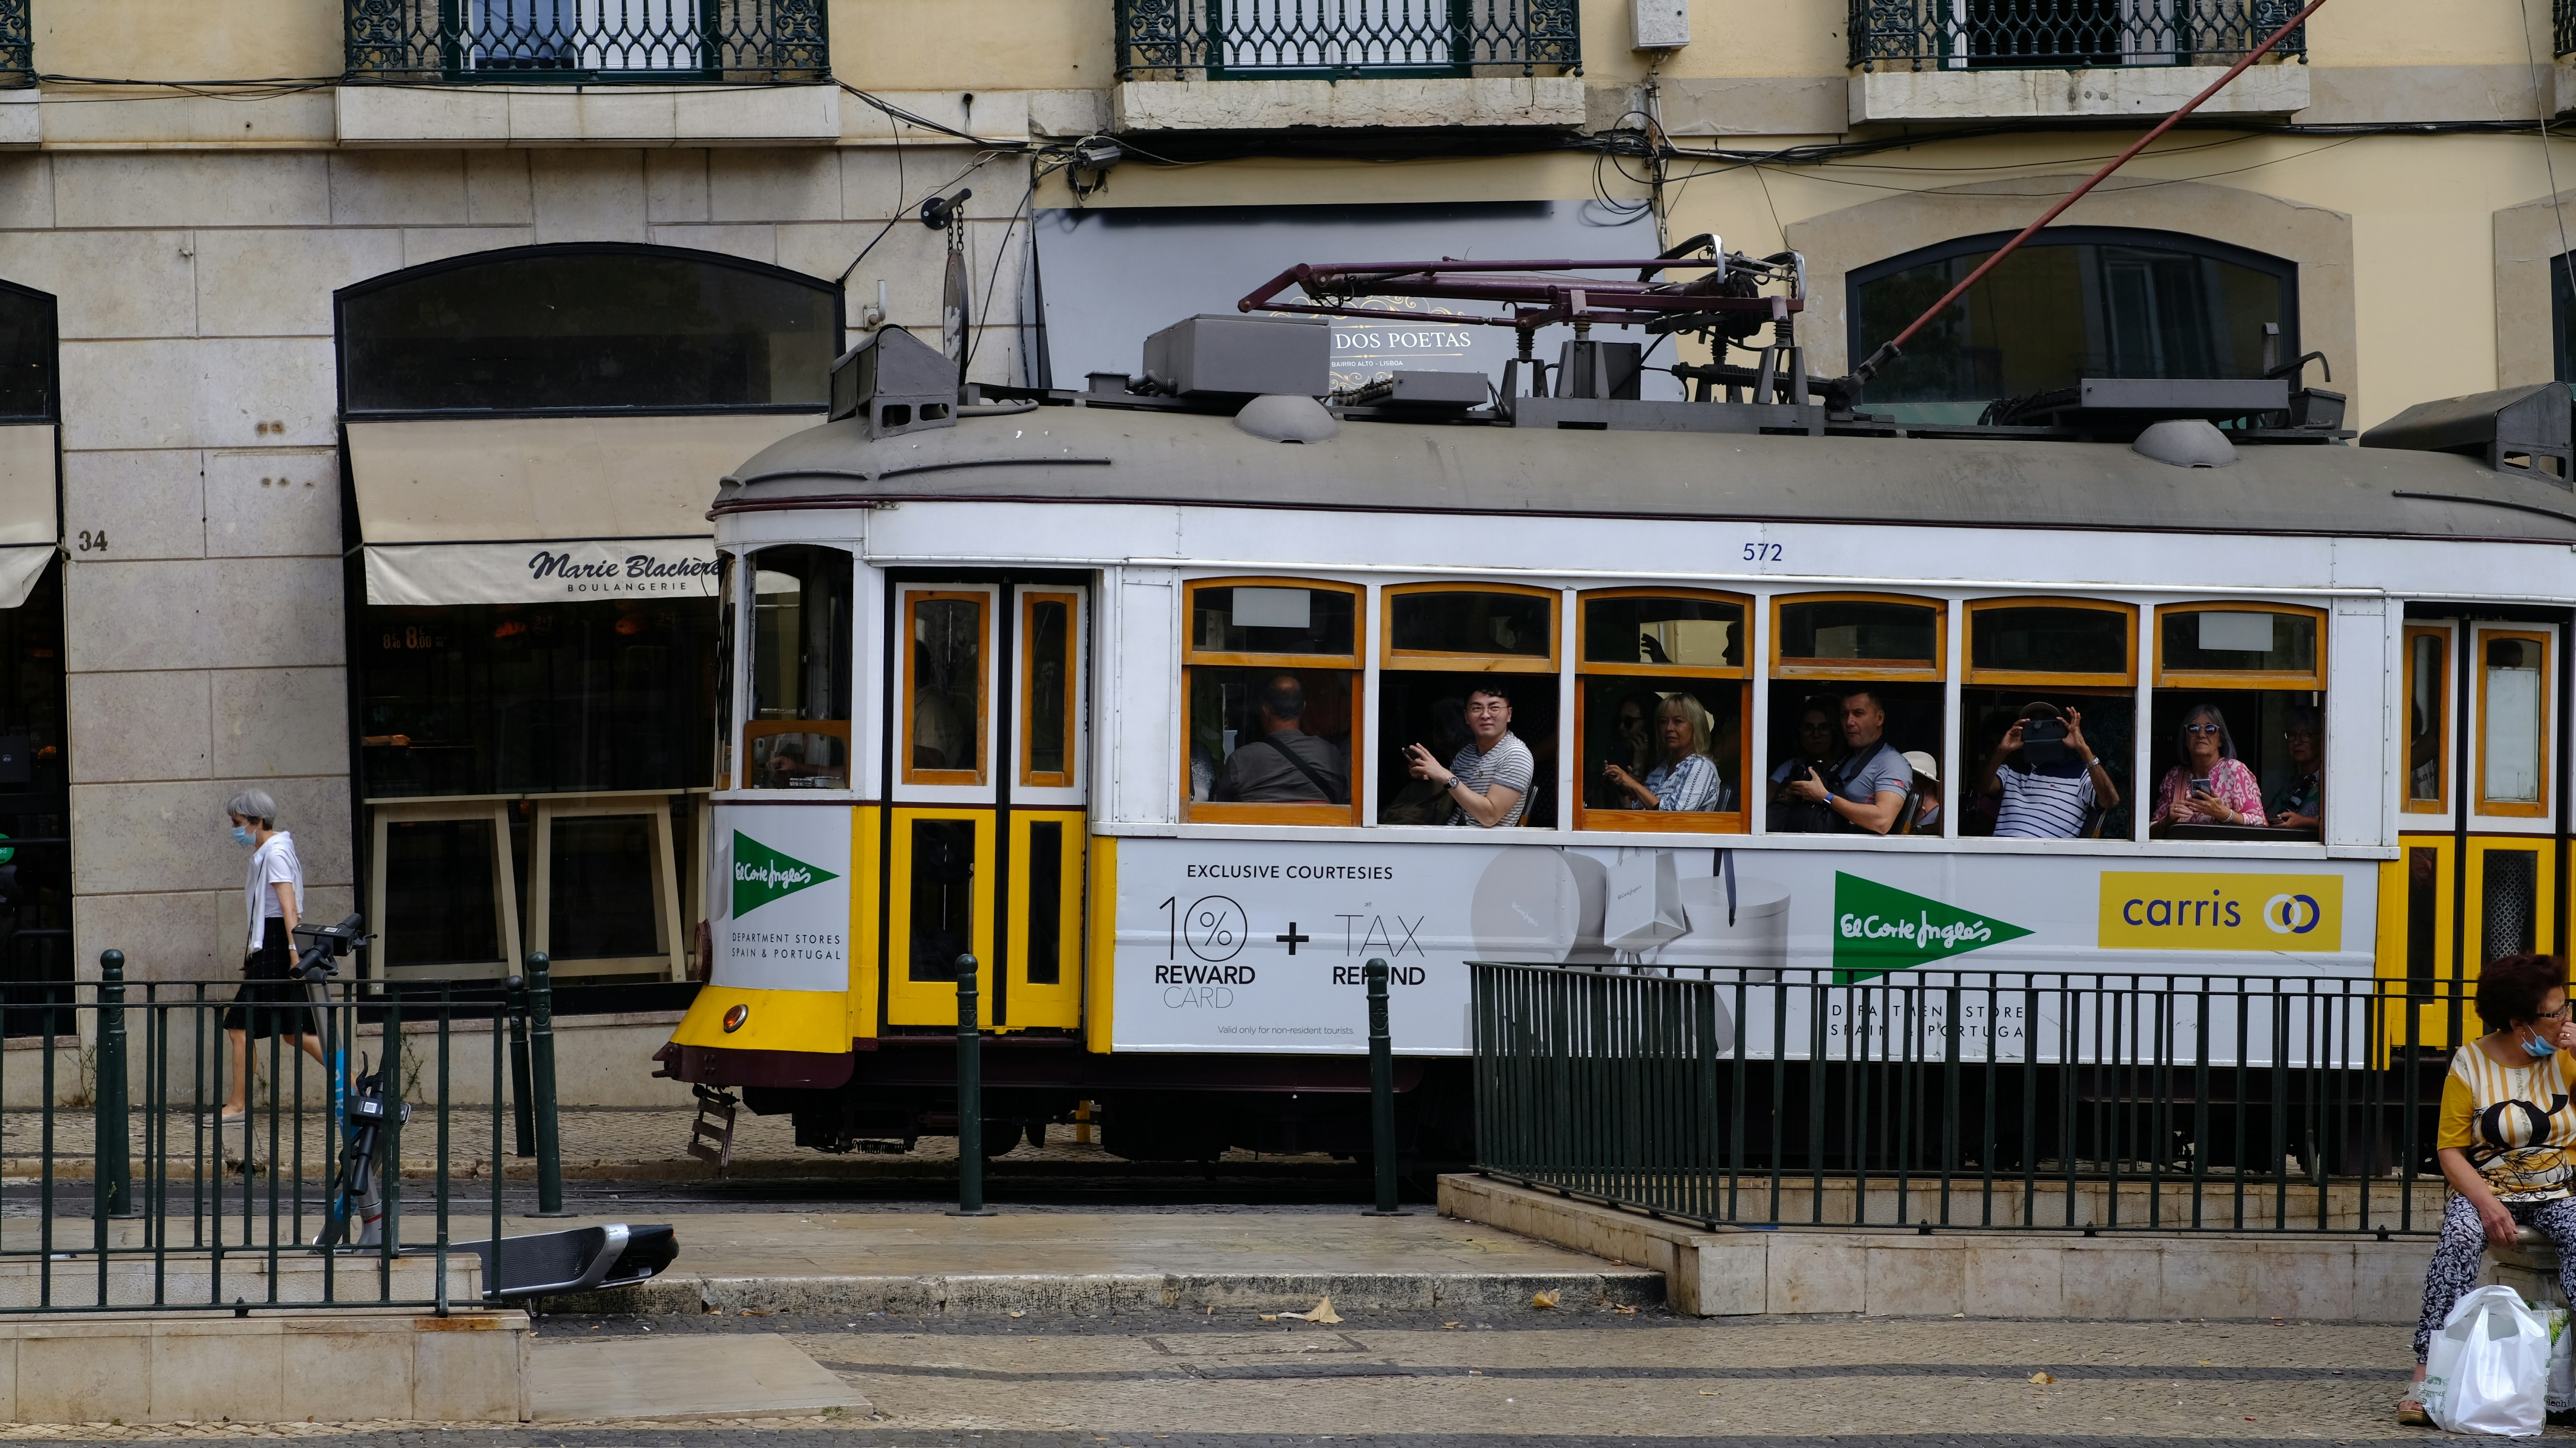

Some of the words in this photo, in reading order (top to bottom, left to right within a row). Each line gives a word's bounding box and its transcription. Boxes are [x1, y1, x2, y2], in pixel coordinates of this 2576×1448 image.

[1334, 333, 1381, 349] DOS
[1388, 332, 1471, 348] POETAS
[79, 530, 108, 552] 34
[1743, 543, 1783, 562] 572
[528, 551, 620, 579] Marie
[625, 554, 719, 578] Blachère
[567, 582, 687, 592] BOULANGERIE
[735, 861, 744, 881] El
[744, 862, 768, 882] Corte
[768, 859, 811, 889] Inglés
[1187, 864, 1279, 878] EXCLUSIVE
[1286, 866, 1393, 879] COURTESIES
[2123, 889, 2241, 927] carris
[732, 932, 789, 943] DEPARTMENT
[796, 934, 840, 944] STORES
[1276, 921, 1309, 955] +
[1334, 915, 1425, 958] TAX
[1840, 913, 1863, 938] El
[1863, 915, 1915, 940] Corte
[1917, 910, 1992, 949] Inglés
[731, 948, 756, 957] SPAIN
[761, 949, 767, 958] &
[774, 949, 841, 960] PORTUGAL
[1155, 965, 1256, 985] REWARD
[1333, 966, 1425, 985] REFND
[1163, 986, 1233, 1009] CARD
[1965, 1006, 2024, 1018] STRE
[1218, 1025, 1238, 1034] Valid
[1239, 1026, 1256, 1035] only
[1258, 1025, 1270, 1034] for
[1272, 1026, 1322, 1034] non-resident
[1928, 1025, 2024, 1038] PORTUGA
